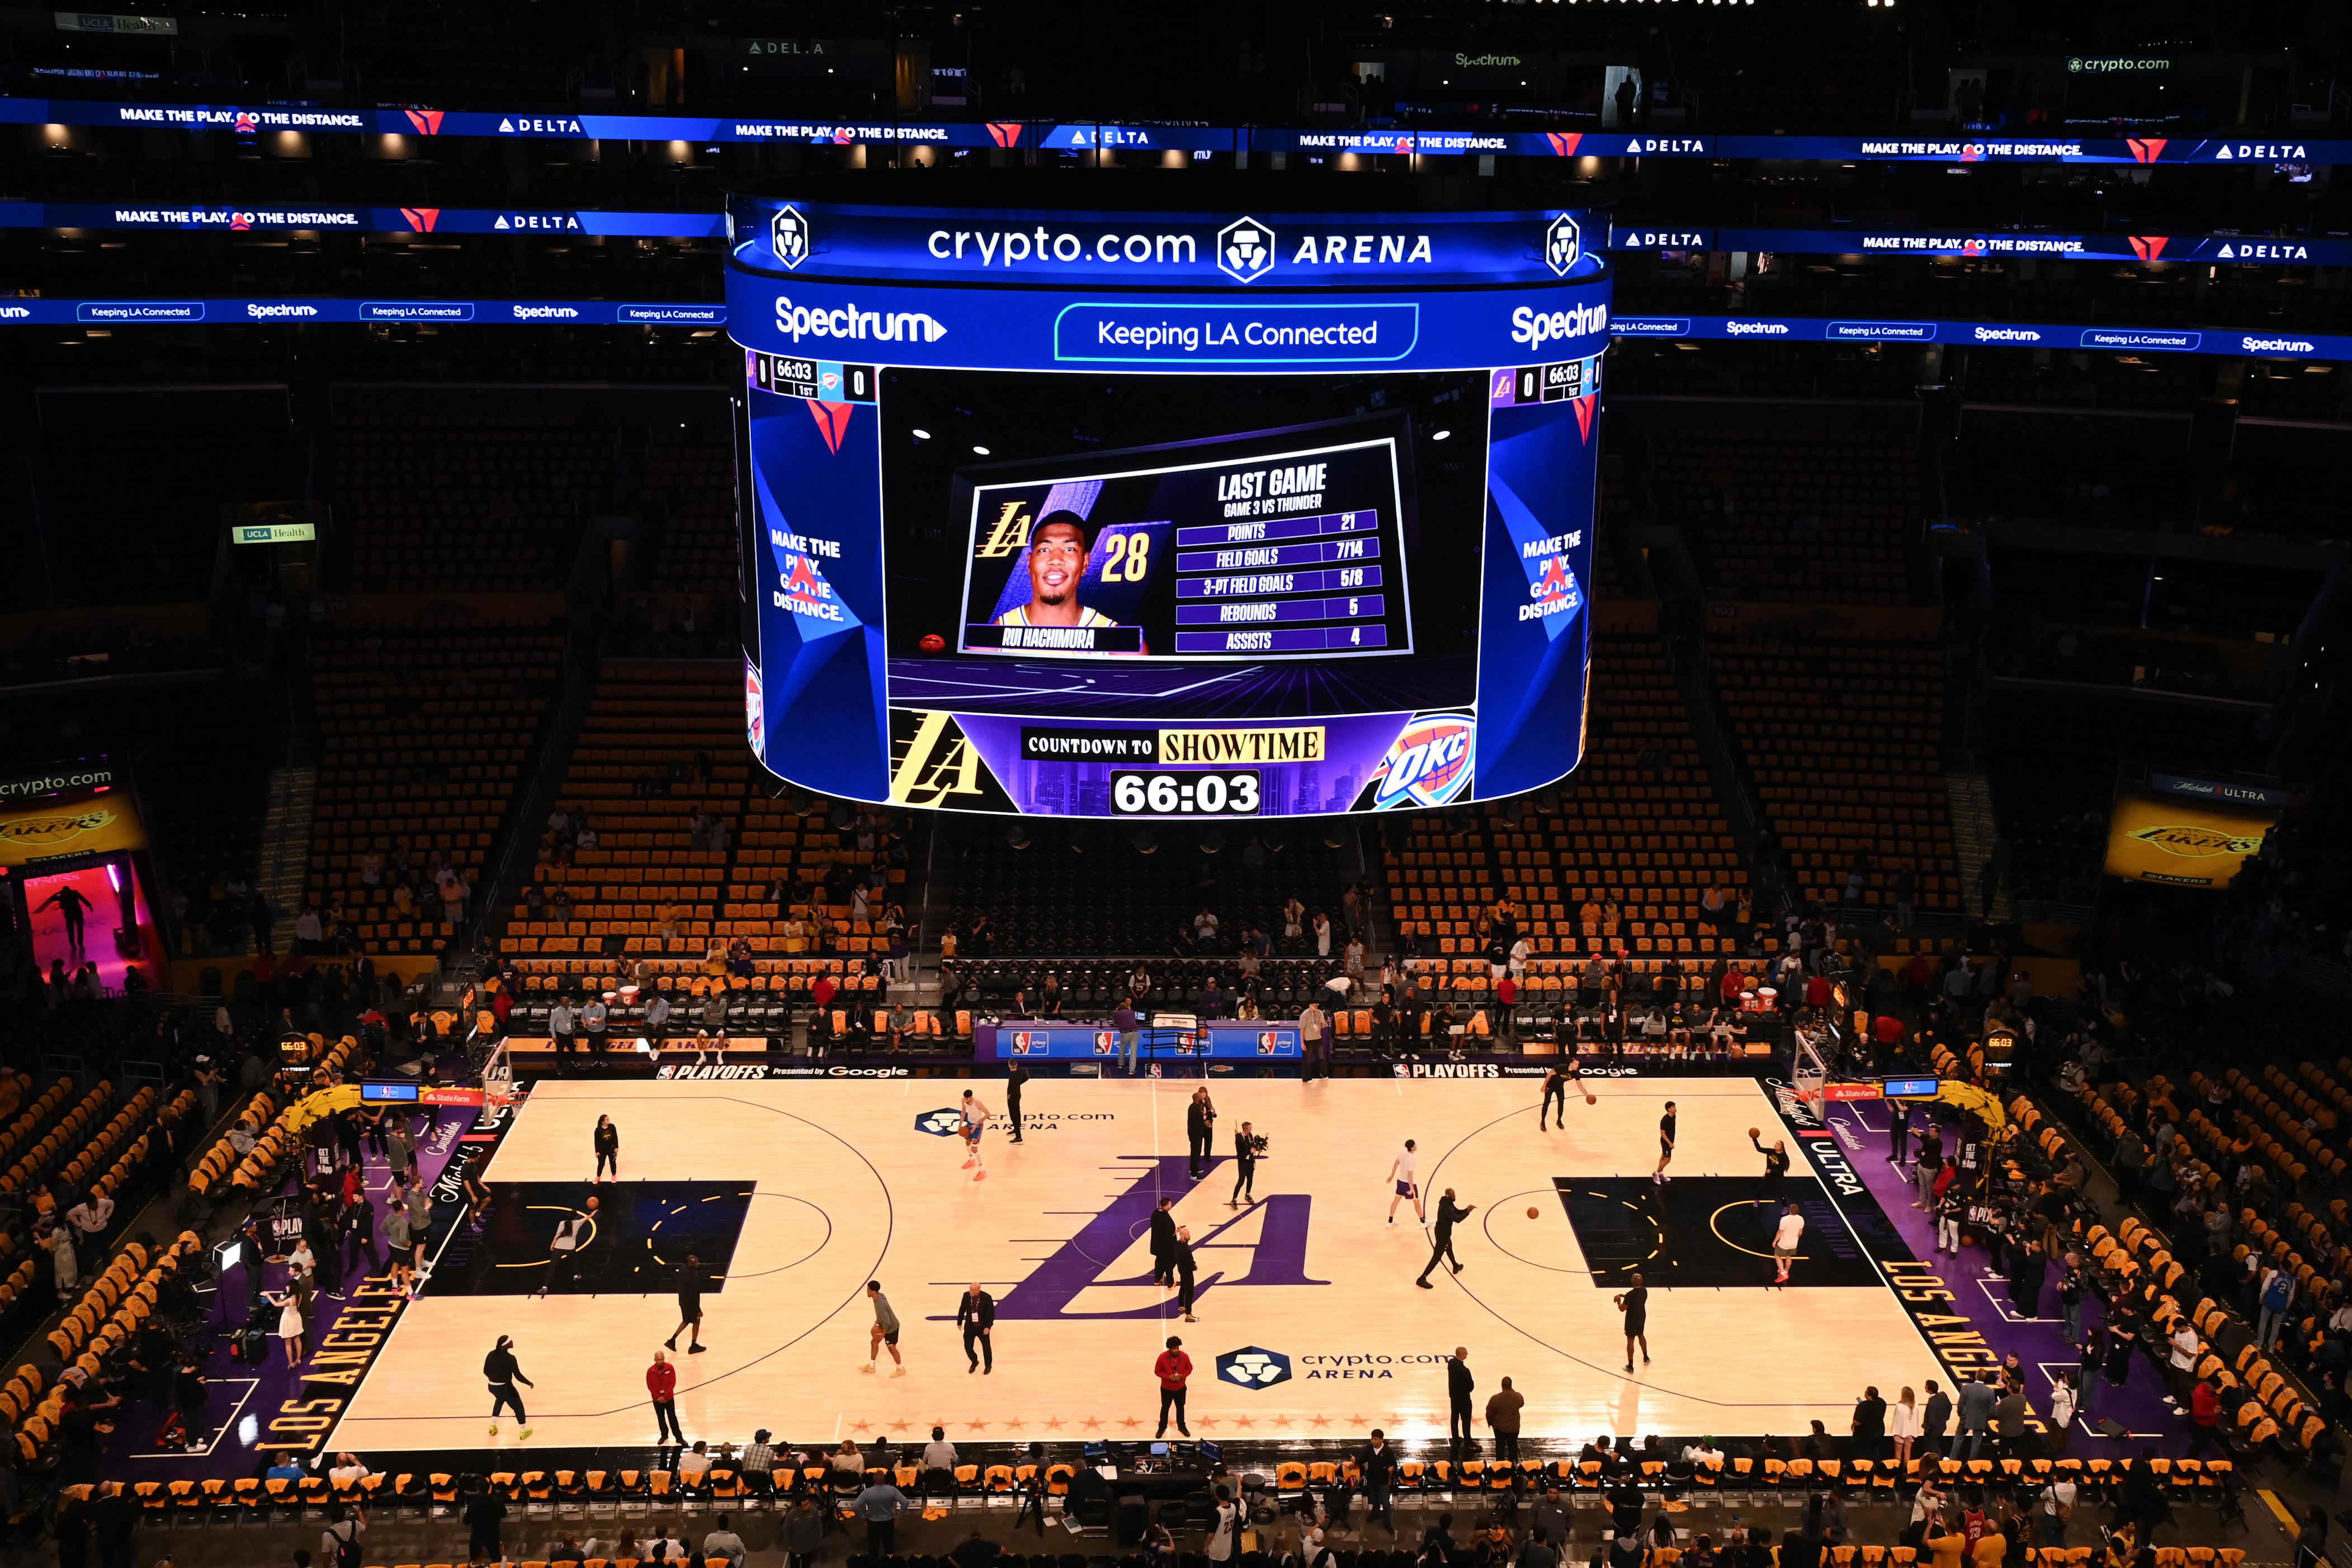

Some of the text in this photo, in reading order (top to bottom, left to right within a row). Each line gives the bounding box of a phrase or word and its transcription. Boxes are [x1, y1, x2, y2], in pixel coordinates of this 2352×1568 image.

[768, 42, 824, 55] DELA
[1456, 53, 1517, 68] Spectrum
[2085, 58, 2169, 72] crypto.com
[120, 108, 362, 126] MAKE THE PLAY. THE DISTANCE.
[519, 119, 580, 132] DELTA
[736, 125, 948, 139] MAKE THE PLAY. THE DISTANCE.
[1646, 140, 1703, 152] DELTA
[1862, 143, 2082, 155] MAKE THE PLAY. THE DISTANCE.
[2239, 146, 2305, 158] DELTA
[116, 211, 358, 224] MAKE THE PLAY. THE DISTANCE.
[514, 216, 578, 229] DELTA
[928, 226, 1432, 266] crypto.com ARENA
[1645, 234, 1702, 245] DELTA
[1864, 238, 2084, 252] MAKE THE PLAY. THE DISTANCE.
[2241, 245, 2307, 258] DELTA
[92, 308, 127, 318] Keeping
[248, 304, 311, 319] Spectrum
[514, 305, 572, 319] Spectrum
[630, 310, 660, 319] Keeping
[776, 297, 933, 342] Spectrum
[1512, 303, 1607, 351] Spectrum
[1727, 322, 1783, 336] Spectrum
[1839, 327, 1869, 336] Keeping
[1975, 327, 2034, 341] Spectrum
[1098, 320, 1377, 351] Keeping LA Connected
[2095, 335, 2127, 344] Keeping
[2141, 337, 2186, 345] Connected
[2242, 337, 2305, 352] Spectrum
[759, 359, 766, 382] 0
[777, 360, 811, 380] 66:03
[1550, 364, 1579, 384] 66:03
[799, 385, 813, 396] 1ST
[853, 371, 865, 395] 0
[1493, 376, 1511, 398] LA
[1524, 372, 1533, 397] 0
[1569, 386, 1578, 397] 1ST
[1218, 464, 1327, 501] LAST GAME
[1224, 494, 1322, 518] GAME 3 VS THUNDER
[247, 527, 305, 538] UCLA Health
[975, 501, 1031, 559] LA
[1228, 513, 1356, 541] POINTS 21
[772, 528, 840, 558] MAKE THE
[1523, 529, 1581, 559] MAKE THE
[1101, 533, 1150, 582] 28
[1216, 540, 1363, 568] FIELD GOALS 7/14
[1203, 569, 1363, 595] 3-PT FIELD GOALS 5/8
[773, 591, 844, 622] DISTANCE.
[1220, 598, 1358, 622] REBOUNDS 5
[1002, 628, 1095, 649] RUI HACHIMURA
[1226, 627, 1361, 650] ASSISTS 4
[1028, 731, 1319, 761] COUNTDOWN TO SHOWTIME
[890, 711, 984, 808] LA
[1390, 729, 1468, 796] OKC
[0, 772, 112, 795] crypto.com
[2174, 781, 2266, 801] Michelob ULTRA
[1114, 775, 1260, 813] 66:03
[2139, 829, 2252, 852] LAKERS
[281, 1042, 305, 1051] 66:03
[1989, 1038, 2013, 1047] 66:03
[674, 1065, 769, 1079] PLAYOFFS
[828, 1066, 909, 1078] Google
[1413, 1064, 1499, 1078] PLAYOFFS
[987, 1112, 1114, 1122] crpto.com
[425, 1122, 462, 1155] Courtside
[1827, 1117, 1865, 1150] Courtside
[1966, 1143, 1976, 1151] GET
[319, 1156, 329, 1165] THE
[1811, 1142, 1864, 1195] ULTRA
[1966, 1161, 1977, 1169] App
[322, 1165, 333, 1174] App
[926, 1155, 1331, 1321] LA
[1881, 1260, 1956, 1302] LOS
[1302, 1353, 1451, 1366] crypto.com
[1306, 1369, 1393, 1379] ARENA
[254, 1399, 343, 1451] LOS
[1969, 1527, 1981, 1539] 23
